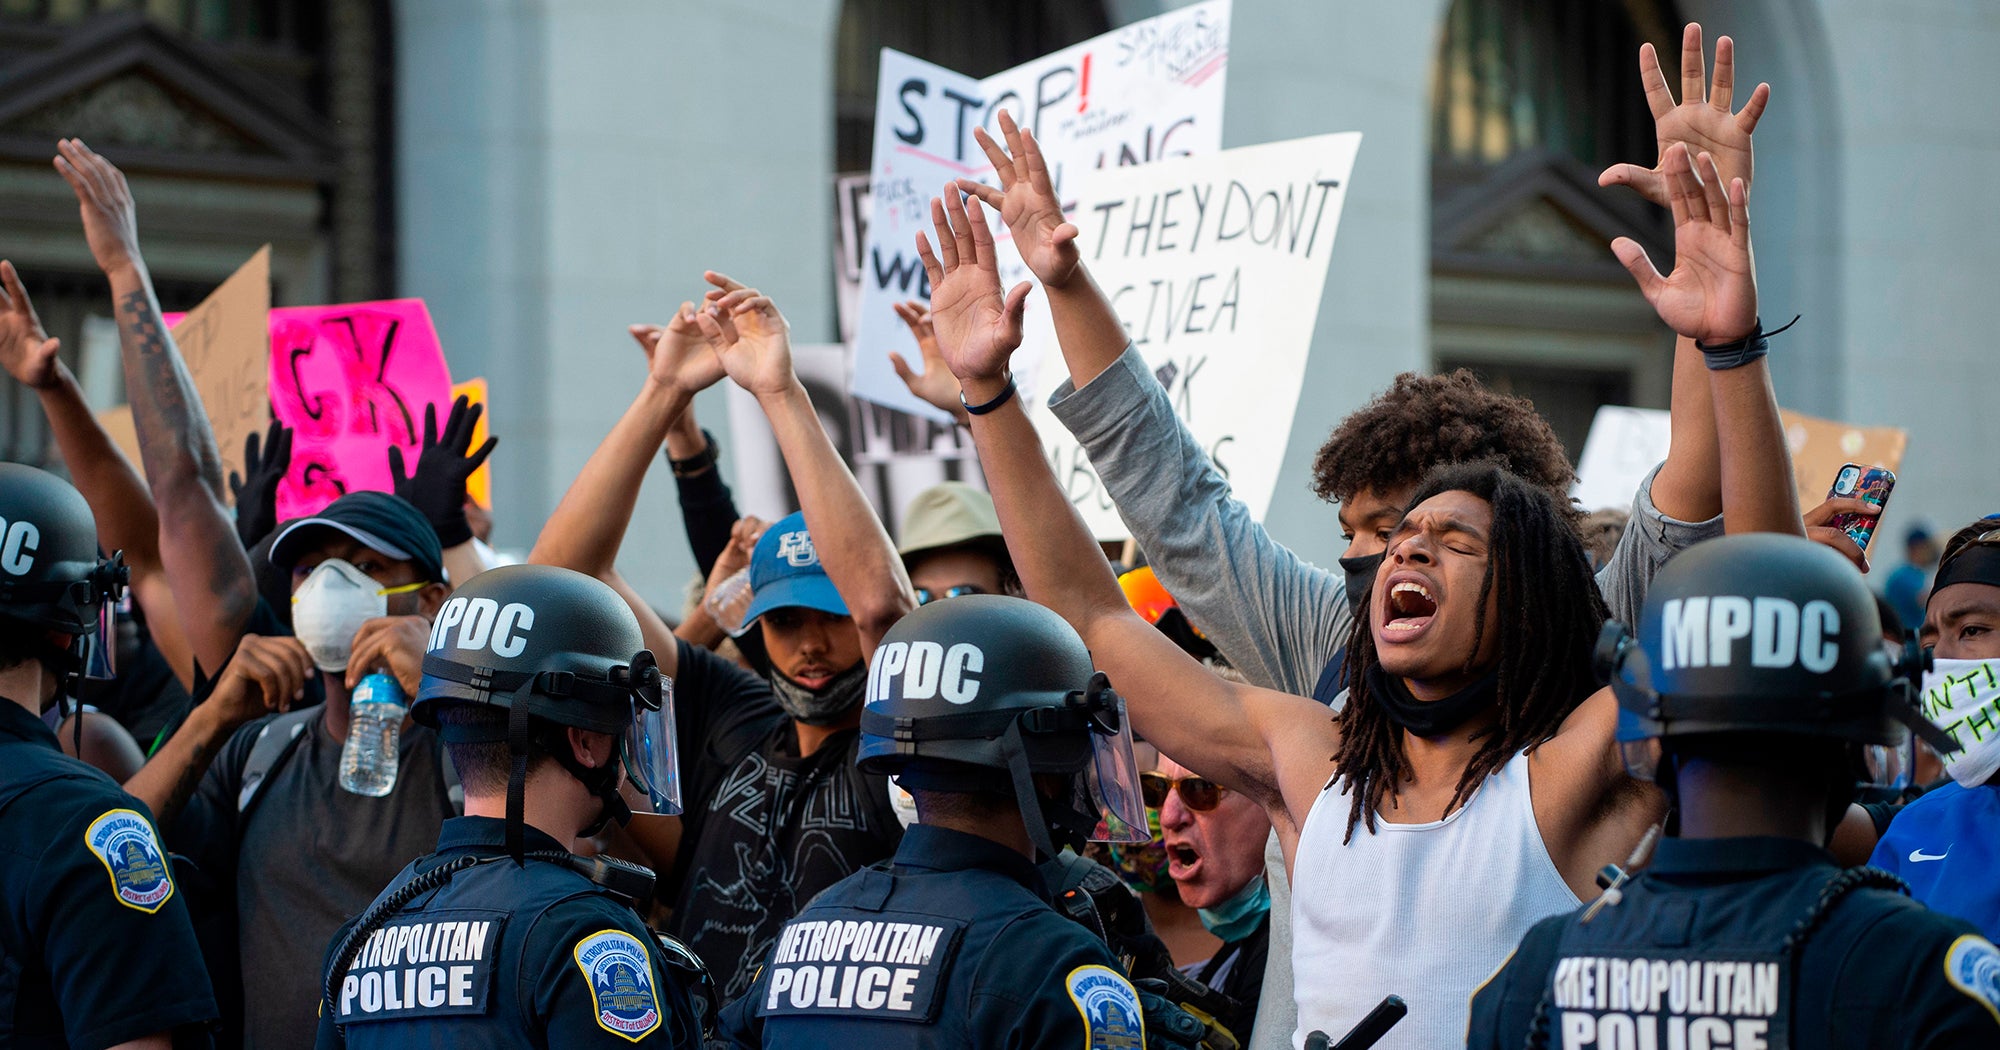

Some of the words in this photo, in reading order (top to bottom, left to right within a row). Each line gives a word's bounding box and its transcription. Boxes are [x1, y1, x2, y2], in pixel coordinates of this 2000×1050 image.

[893, 53, 1092, 160] STOP!
[1094, 183, 1212, 260] THEY
[0, 515, 41, 576] C
[1662, 595, 1842, 675] MPDC
[350, 922, 490, 970] TROPOLITAN
[580, 940, 626, 966] METROPOLITAN
[626, 942, 647, 964] POLICE
[774, 920, 944, 966] METROPOLITAN
[341, 966, 474, 1016] POLICE
[767, 966, 921, 1011] POLICE
[1553, 957, 1780, 1016] METROPOLITAN
[602, 1011, 629, 1029] DISTRICT
[1561, 1011, 1770, 1050] POLICE
